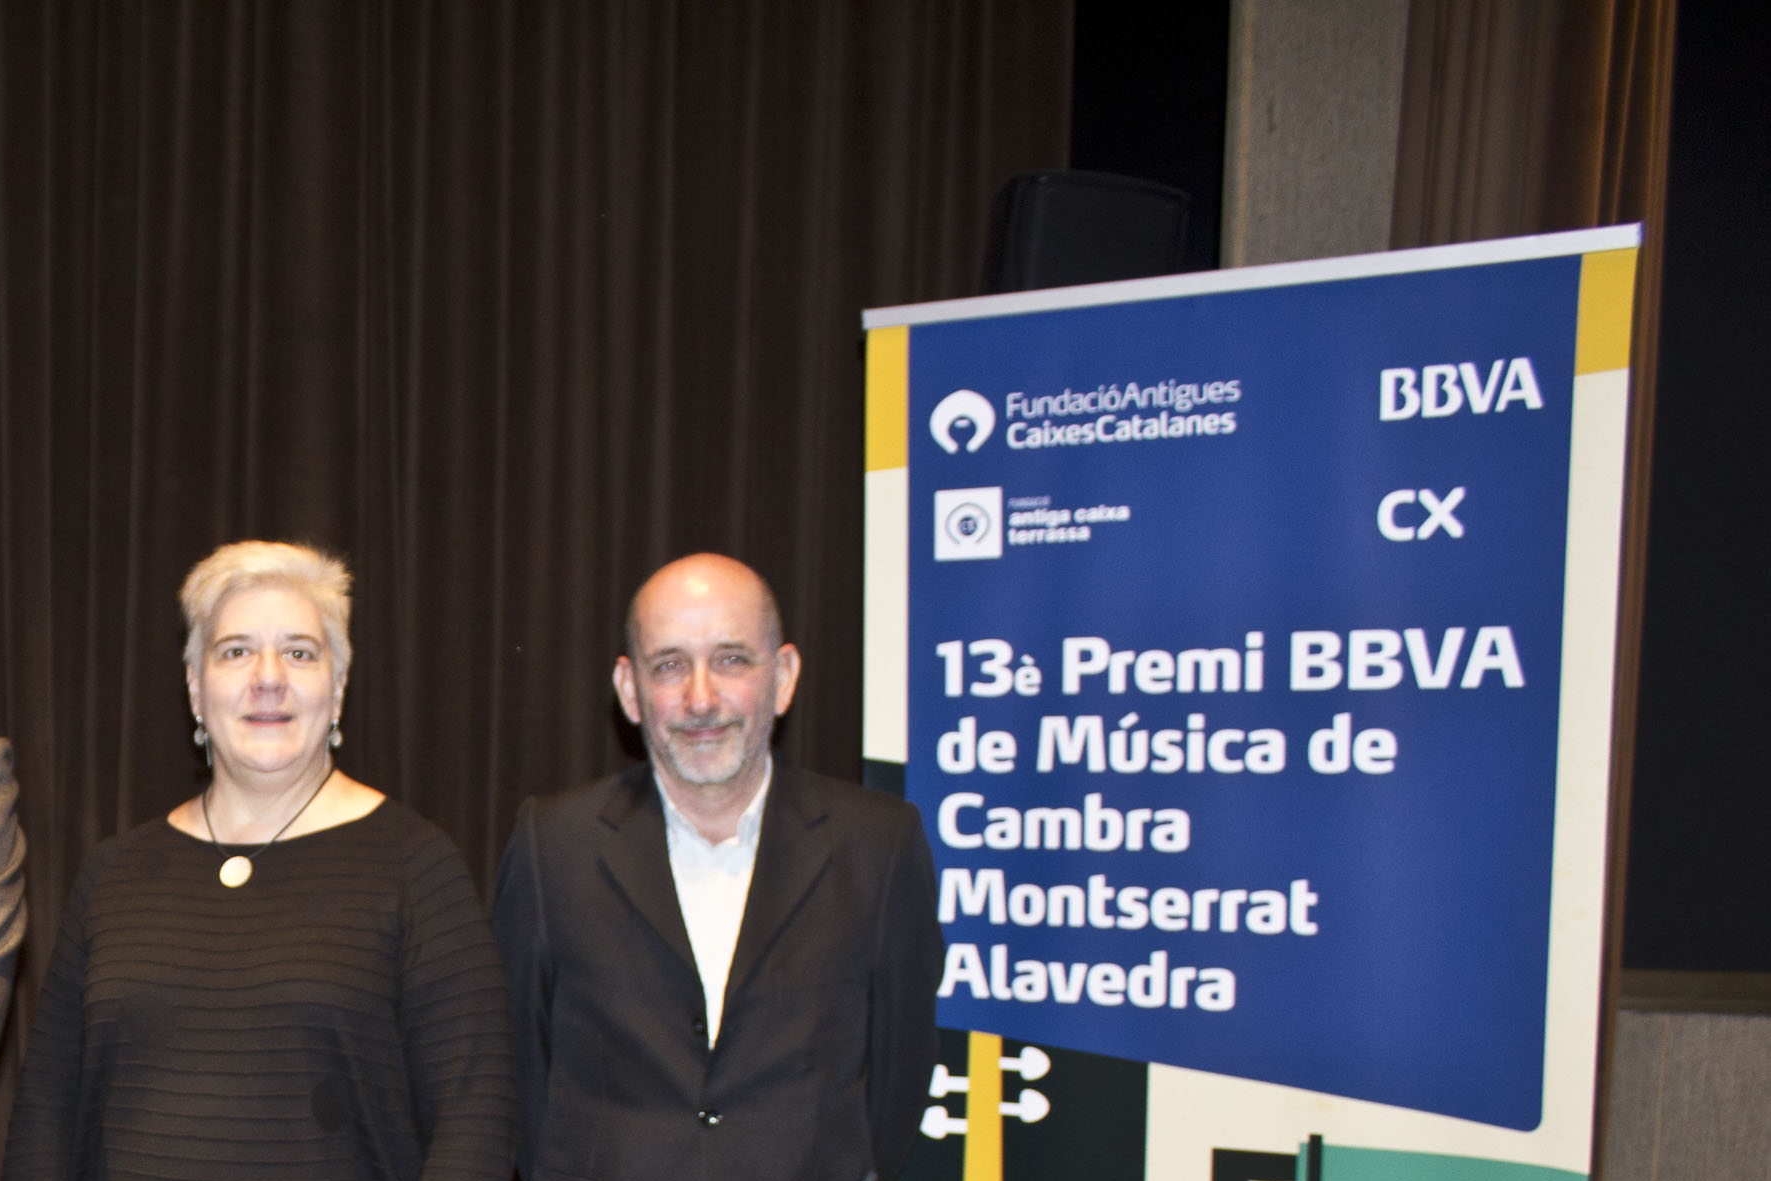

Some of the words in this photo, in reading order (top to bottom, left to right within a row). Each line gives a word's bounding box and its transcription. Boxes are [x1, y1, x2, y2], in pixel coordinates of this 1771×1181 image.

[1006, 379, 1242, 420] FundacióAntigues
[1380, 357, 1543, 421] BBVA
[1006, 410, 1237, 450] CaixesCatalanes
[1008, 508, 1071, 527] antiga
[1074, 504, 1131, 523] caixa
[1008, 525, 1091, 545] terrassa
[1377, 486, 1466, 541] CX
[936, 638, 1042, 698] 13è
[1062, 631, 1264, 695] Premi
[1290, 626, 1526, 691] BBVA
[937, 715, 1017, 774] de
[1037, 711, 1287, 774] Música
[1308, 712, 1398, 774] de
[938, 792, 1191, 853] Cambra
[938, 868, 1319, 936] Montserrat
[937, 943, 1236, 1012] Alavedra
